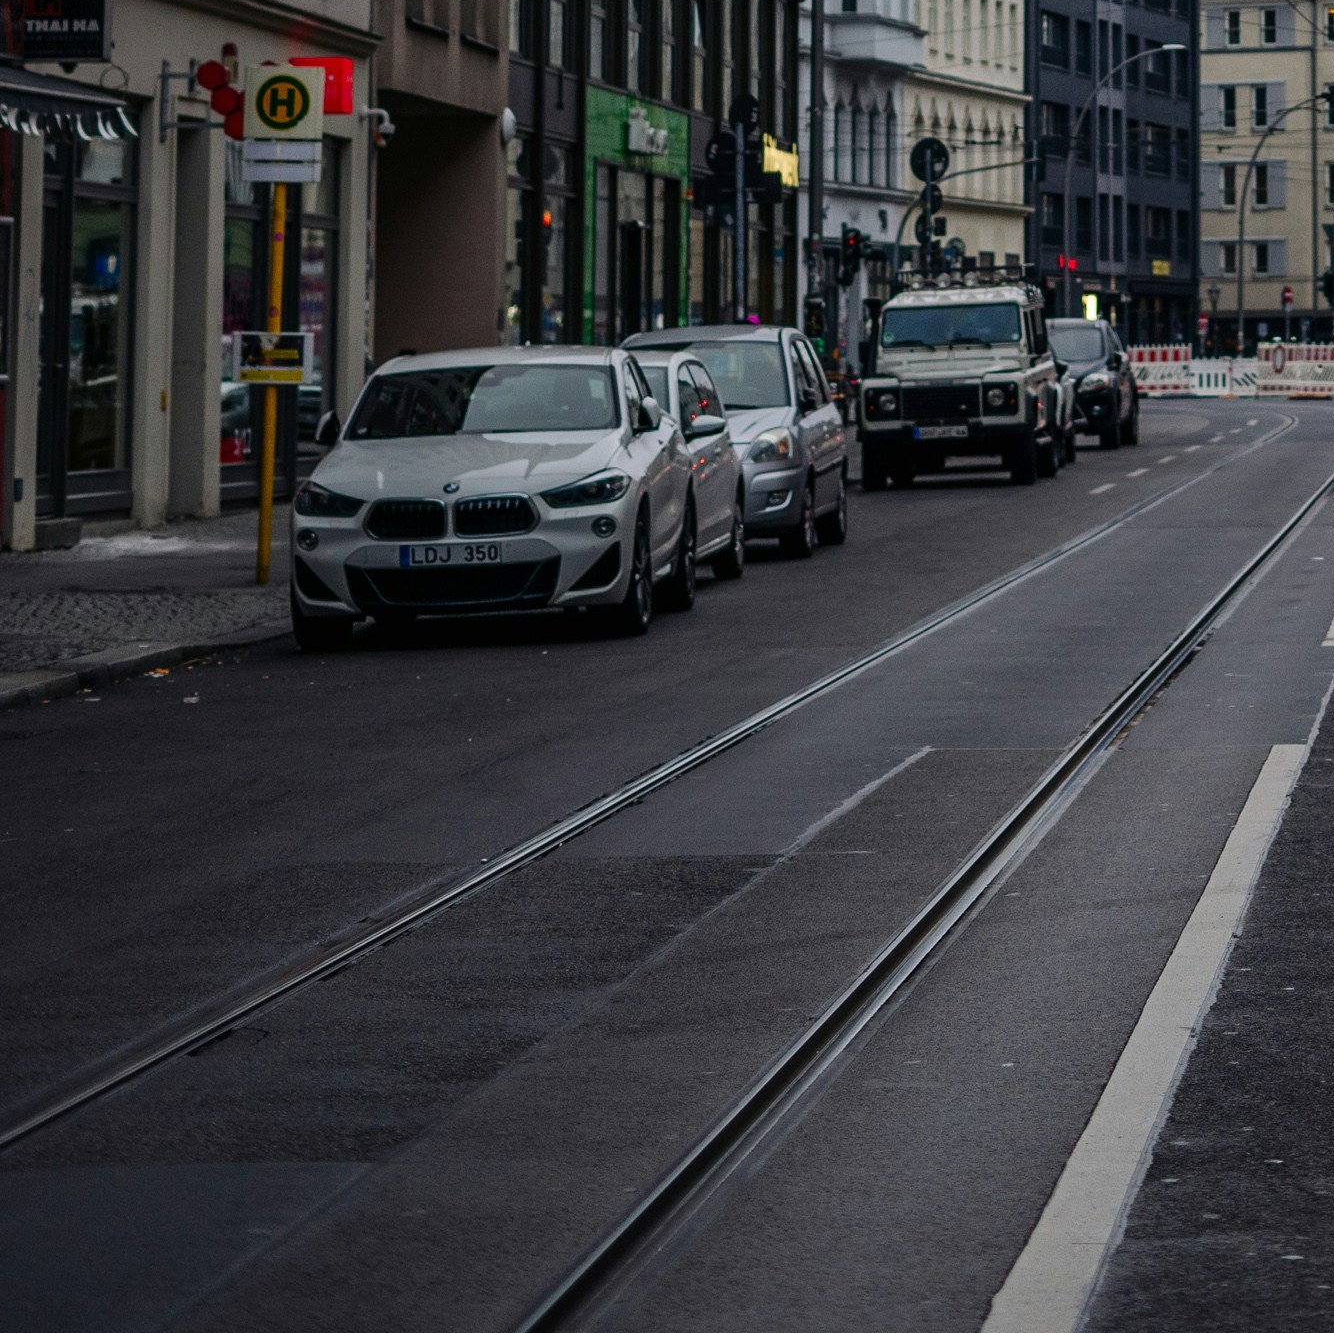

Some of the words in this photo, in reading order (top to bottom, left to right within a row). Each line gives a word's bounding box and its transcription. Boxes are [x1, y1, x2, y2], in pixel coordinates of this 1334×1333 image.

[270, 88, 296, 118] H
[412, 547, 451, 564] LDJ
[464, 544, 499, 563] 350
